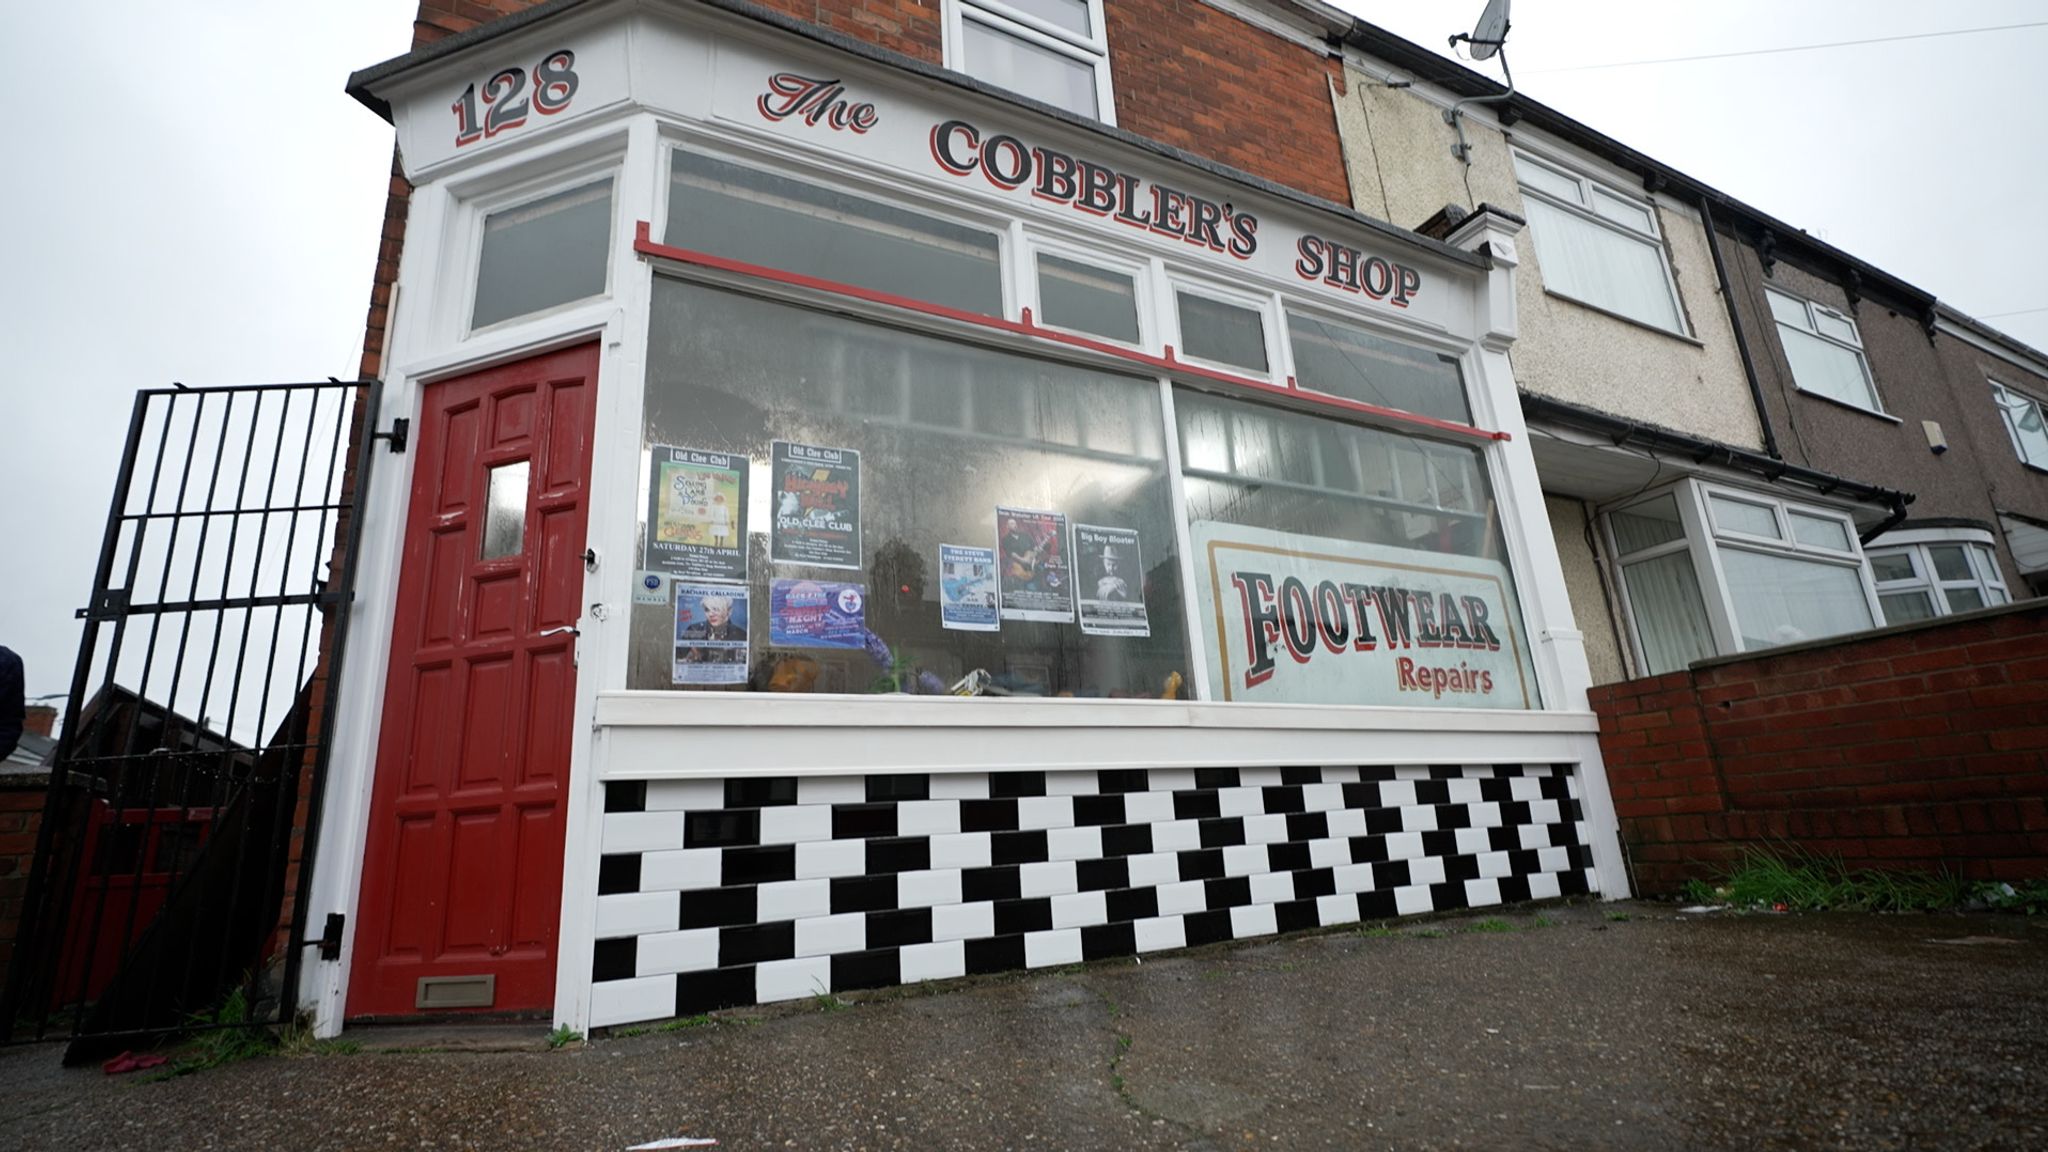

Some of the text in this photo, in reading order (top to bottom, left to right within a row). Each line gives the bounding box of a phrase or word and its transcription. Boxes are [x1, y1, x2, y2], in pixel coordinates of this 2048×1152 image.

[451, 48, 581, 147] 128
[756, 72, 1421, 307] The COBBLER'S SHOP
[675, 451, 727, 465] Old Clee Club
[793, 446, 839, 460] Old Clee Club
[780, 516, 853, 532] OLD CLEE CLUB
[1081, 532, 1093, 543] Big
[1094, 533, 1108, 544] Boy
[653, 542, 742, 557] SATURDAY 27th APRIL
[1231, 570, 1501, 689] FOOTWEAR
[1396, 657, 1494, 698] Repairs
